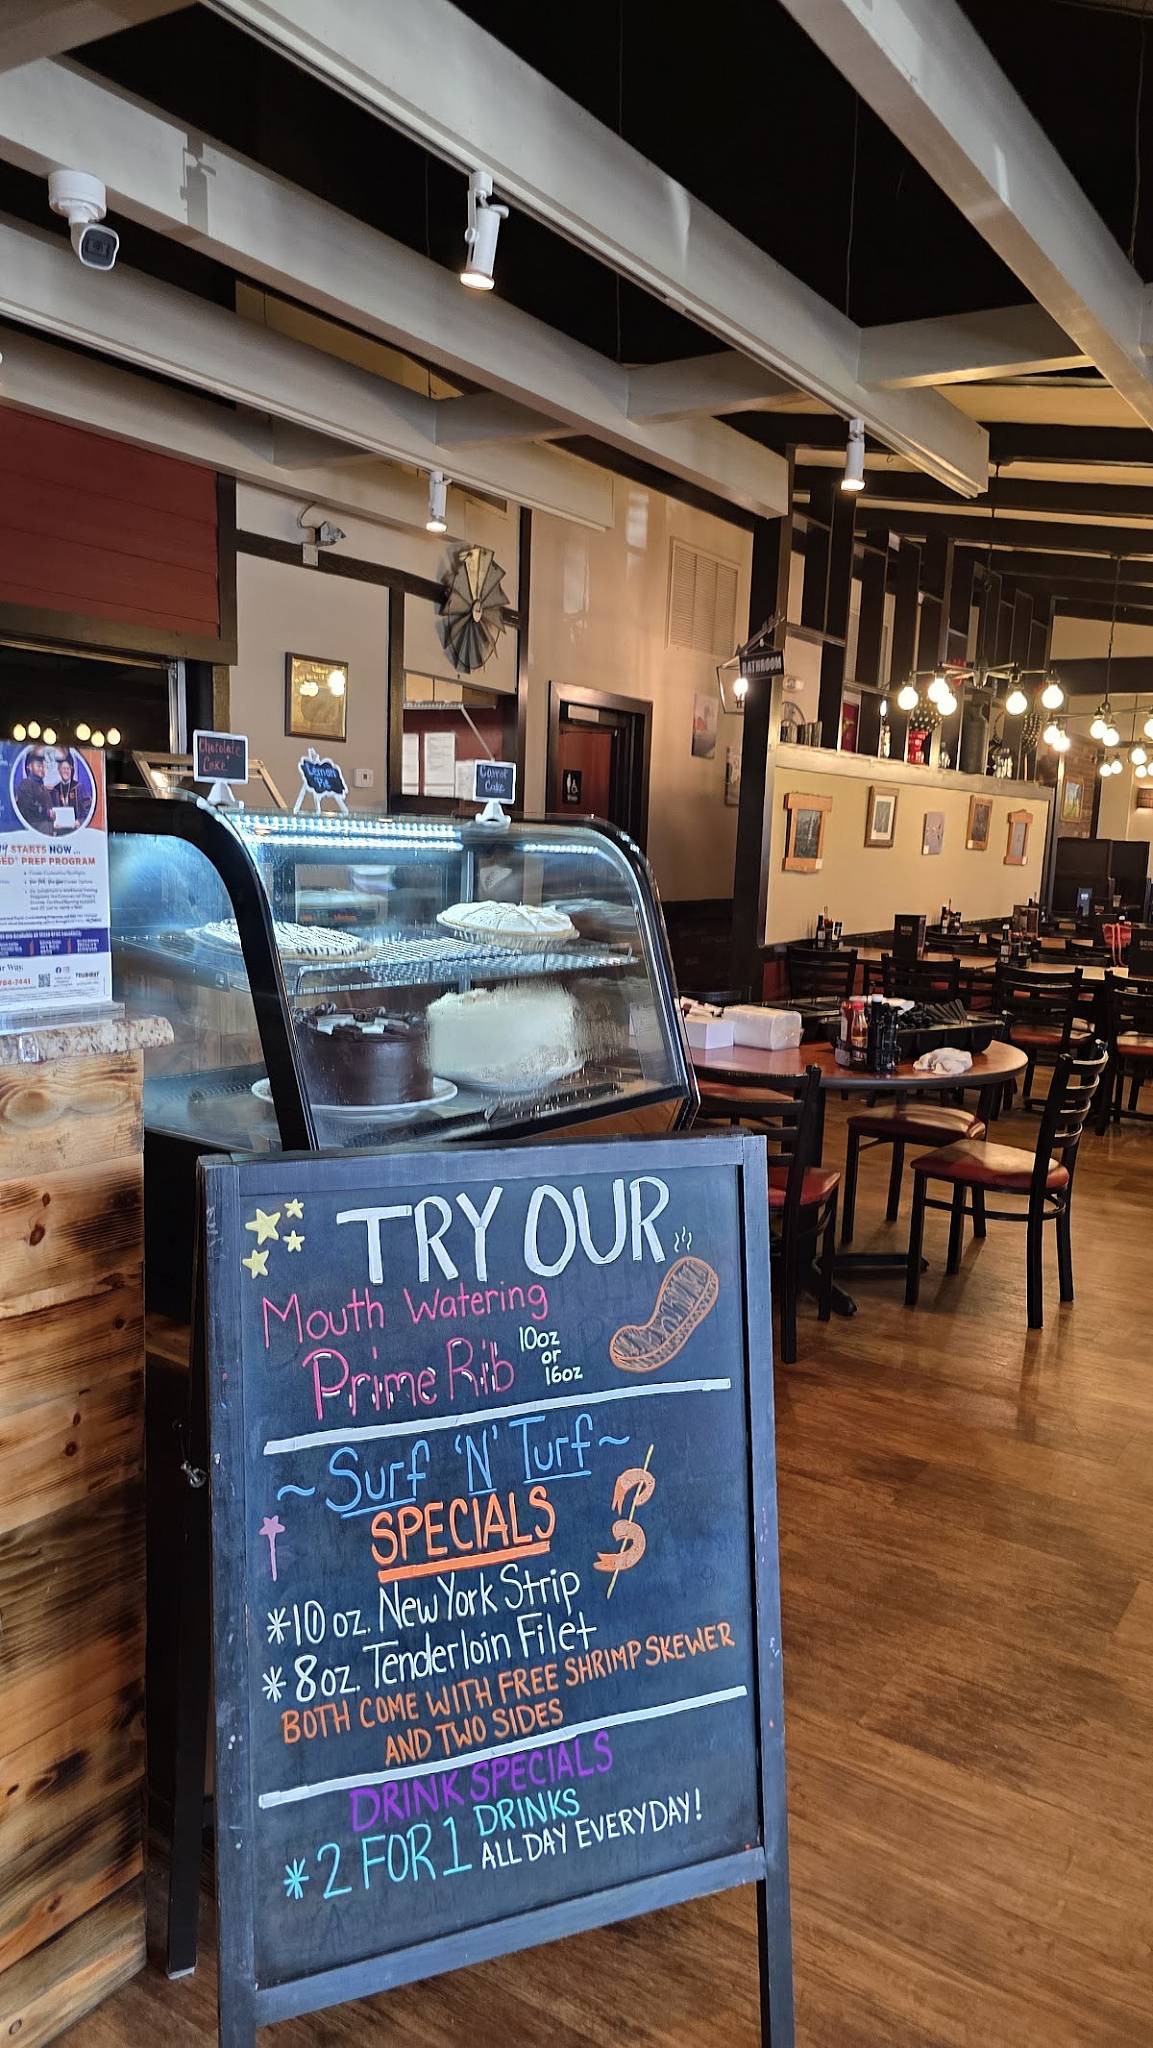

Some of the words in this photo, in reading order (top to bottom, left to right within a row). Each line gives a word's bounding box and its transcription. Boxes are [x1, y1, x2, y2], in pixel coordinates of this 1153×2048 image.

[742, 656, 782, 673] BATHROOM
[10, 845, 47, 854] STARTS
[21, 857, 46, 865] PREP
[49, 857, 96, 865] PROGRAM
[337, 1187, 502, 1284] TRY
[524, 1177, 670, 1277] OUR
[262, 1293, 385, 1349] Mouth
[403, 1281, 548, 1325] Watering
[519, 1326, 560, 1352] 10oz
[302, 1347, 437, 1421] Prime
[446, 1337, 515, 1400] Rib
[541, 1349, 562, 1365] or
[545, 1365, 583, 1386] 16oz
[325, 1440, 430, 1512] Surf
[371, 1486, 557, 1566] SPECIALS
[500, 1563, 581, 1616] Strip
[281, 1700, 351, 1745] BOTH
[360, 1692, 419, 1728] COME
[426, 1676, 493, 1717] WITH
[499, 1664, 559, 1704] FREE
[564, 1640, 642, 1687] SHRIMP
[645, 1622, 736, 1667] SKEWER
[363, 1629, 512, 1689] Tenderloin
[517, 1611, 597, 1658] Filet
[385, 1728, 432, 1767] AND
[435, 1715, 487, 1756] TWO
[492, 1699, 564, 1739] SIDES
[350, 1770, 465, 1832] DRINK
[470, 1730, 613, 1801] SPECIALS
[361, 1823, 437, 1889] FOR
[442, 1816, 473, 1876] 1
[473, 1788, 581, 1836] DRINKS
[481, 1838, 522, 1869] ALL
[523, 1822, 567, 1862] DAY
[575, 1787, 703, 1848] EVERYDAY!
